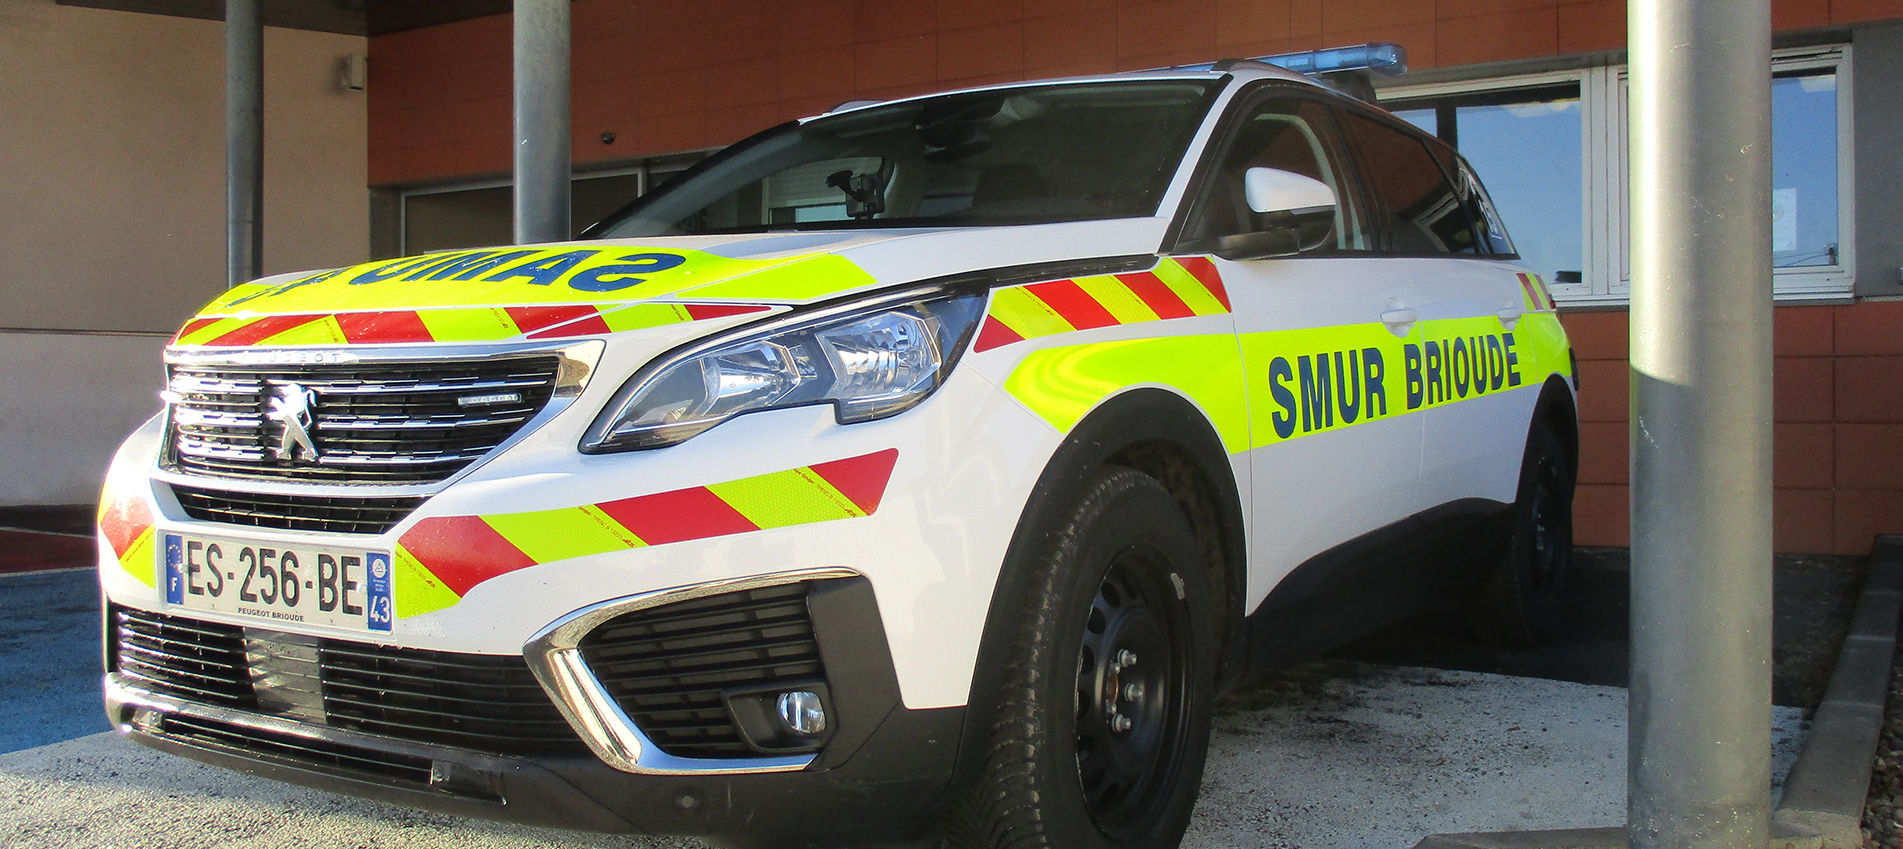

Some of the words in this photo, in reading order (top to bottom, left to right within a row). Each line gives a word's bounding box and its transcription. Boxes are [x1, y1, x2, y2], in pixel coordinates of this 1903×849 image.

[1268, 347, 1387, 439] SMUR
[1403, 333, 1522, 410] BRIOUDE
[171, 577, 178, 592] F
[187, 540, 363, 616] ES-256-BE
[238, 606, 271, 618] PEUGEOT
[271, 611, 305, 622] BRIOUDE
[369, 595, 391, 623] 43
